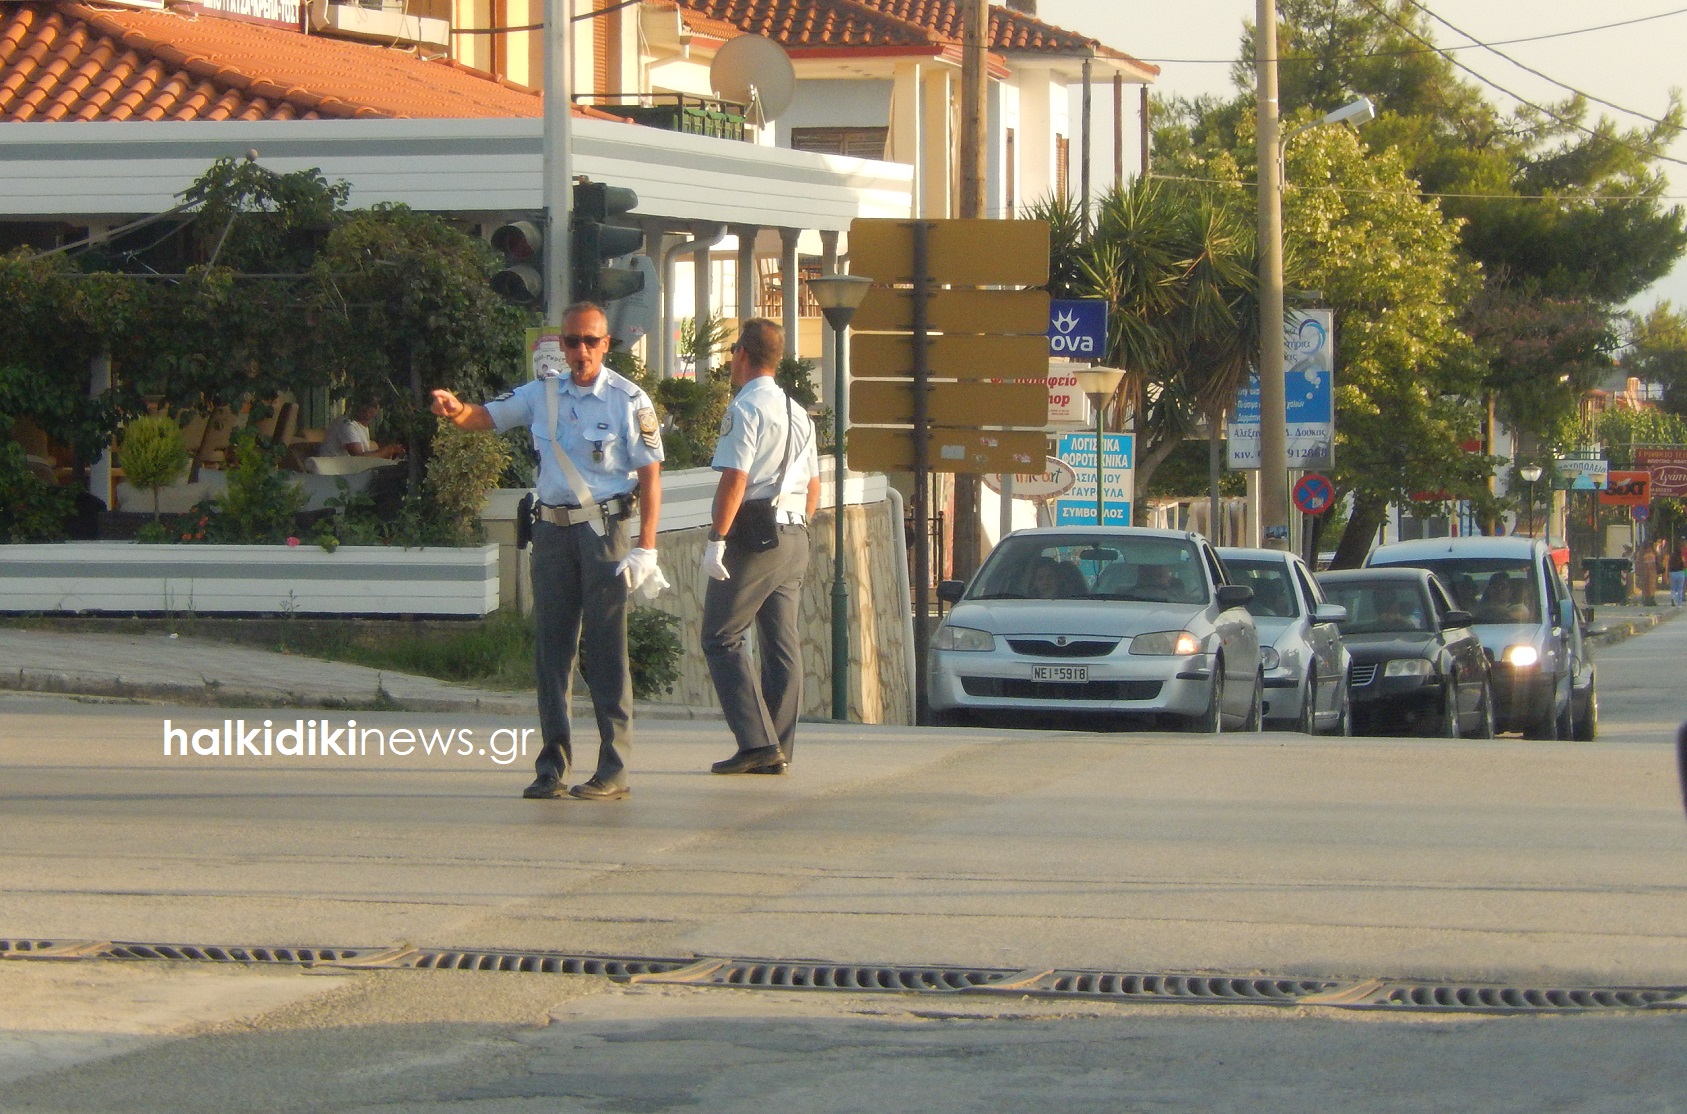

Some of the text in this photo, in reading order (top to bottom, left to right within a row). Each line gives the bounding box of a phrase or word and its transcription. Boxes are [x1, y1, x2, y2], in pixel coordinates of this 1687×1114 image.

[1051, 335, 1094, 352] ova
[1071, 437, 1119, 452] ΛΟΓΙΣΙΚΑ
[1062, 507, 1123, 518] ΣΥΜΒΟΛΟΣ
